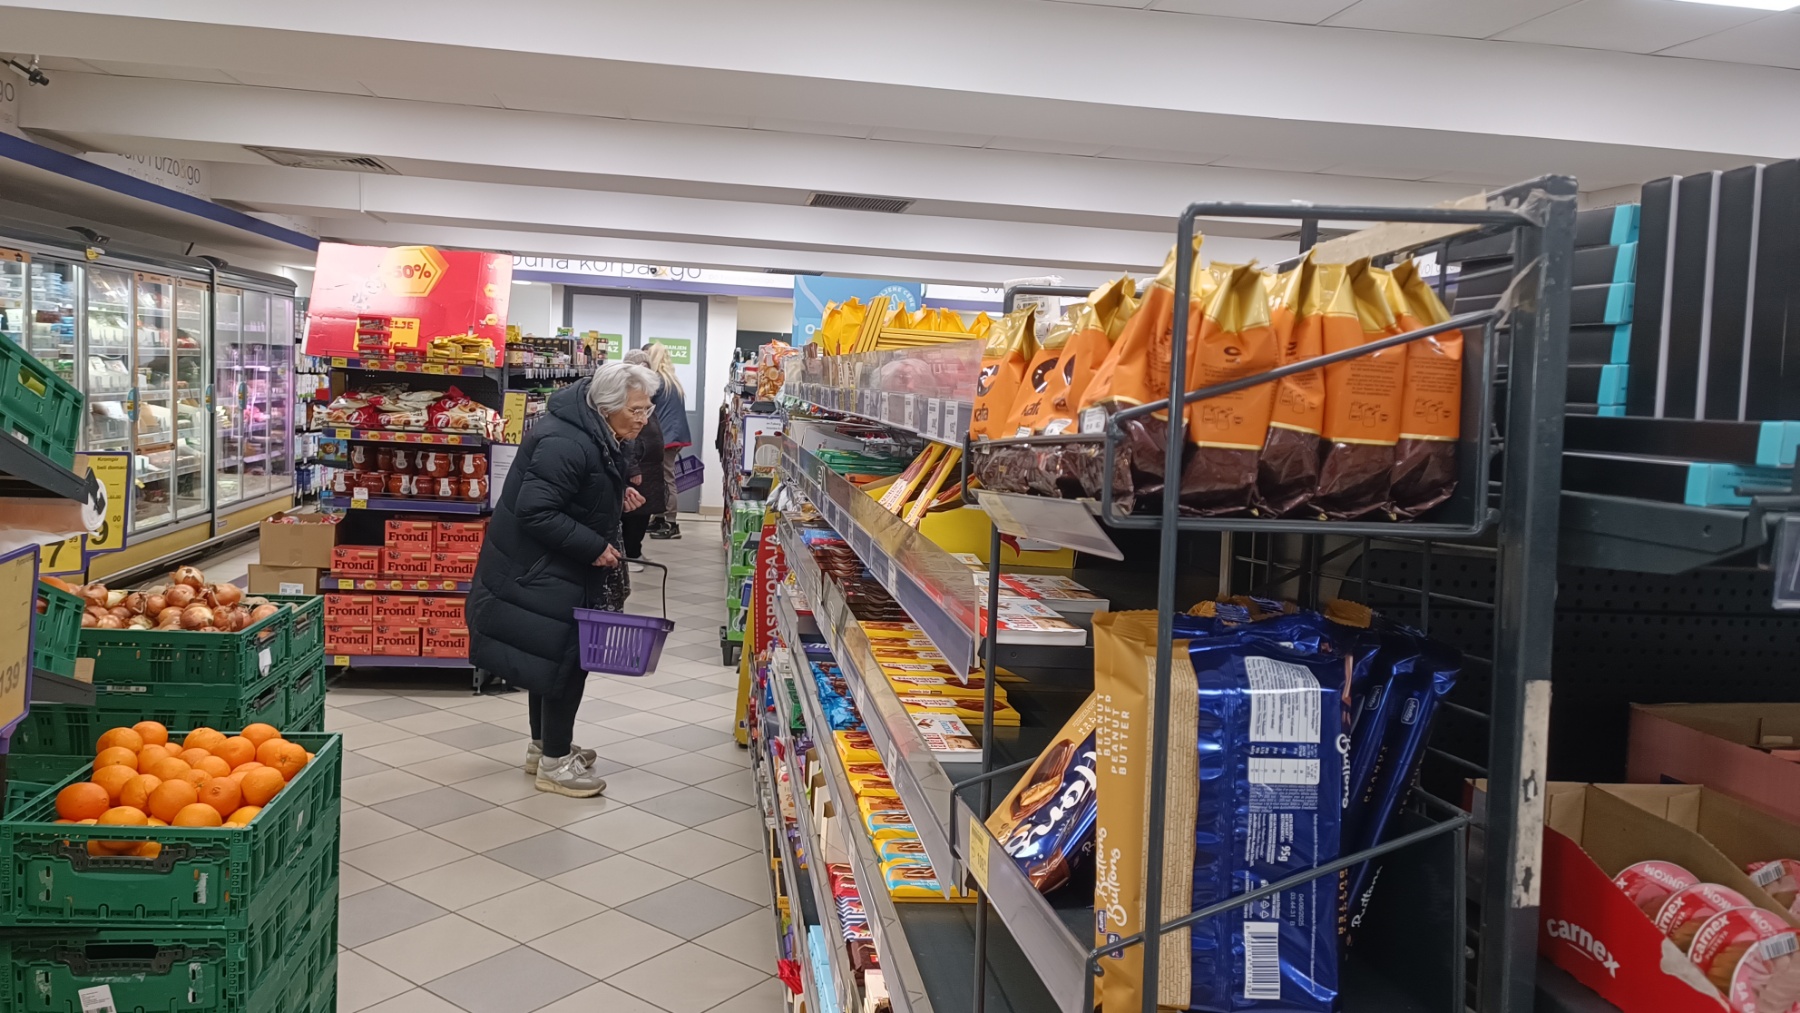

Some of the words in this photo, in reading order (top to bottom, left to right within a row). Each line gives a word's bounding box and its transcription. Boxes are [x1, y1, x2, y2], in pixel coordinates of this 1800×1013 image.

[388, 532, 428, 542] Frondi
[440, 533, 480, 543] Frondi
[334, 560, 375, 571] Frondi
[387, 562, 427, 572] Frondi
[434, 564, 474, 574] Frondi
[328, 606, 369, 616] Frondi
[376, 606, 416, 616] Frondi
[421, 608, 461, 618] Frondi
[328, 634, 368, 645] Frondi
[376, 636, 416, 646] Frondi
[426, 638, 465, 648] Frondi
[1111, 708, 1120, 774] PEANUT
[1118, 710, 1130, 776] BUTTER
[1278, 845, 1291, 862] 95g
[1106, 847, 1128, 927] Buttons
[1692, 914, 1730, 963] carnex
[1546, 918, 1620, 979] carnex
